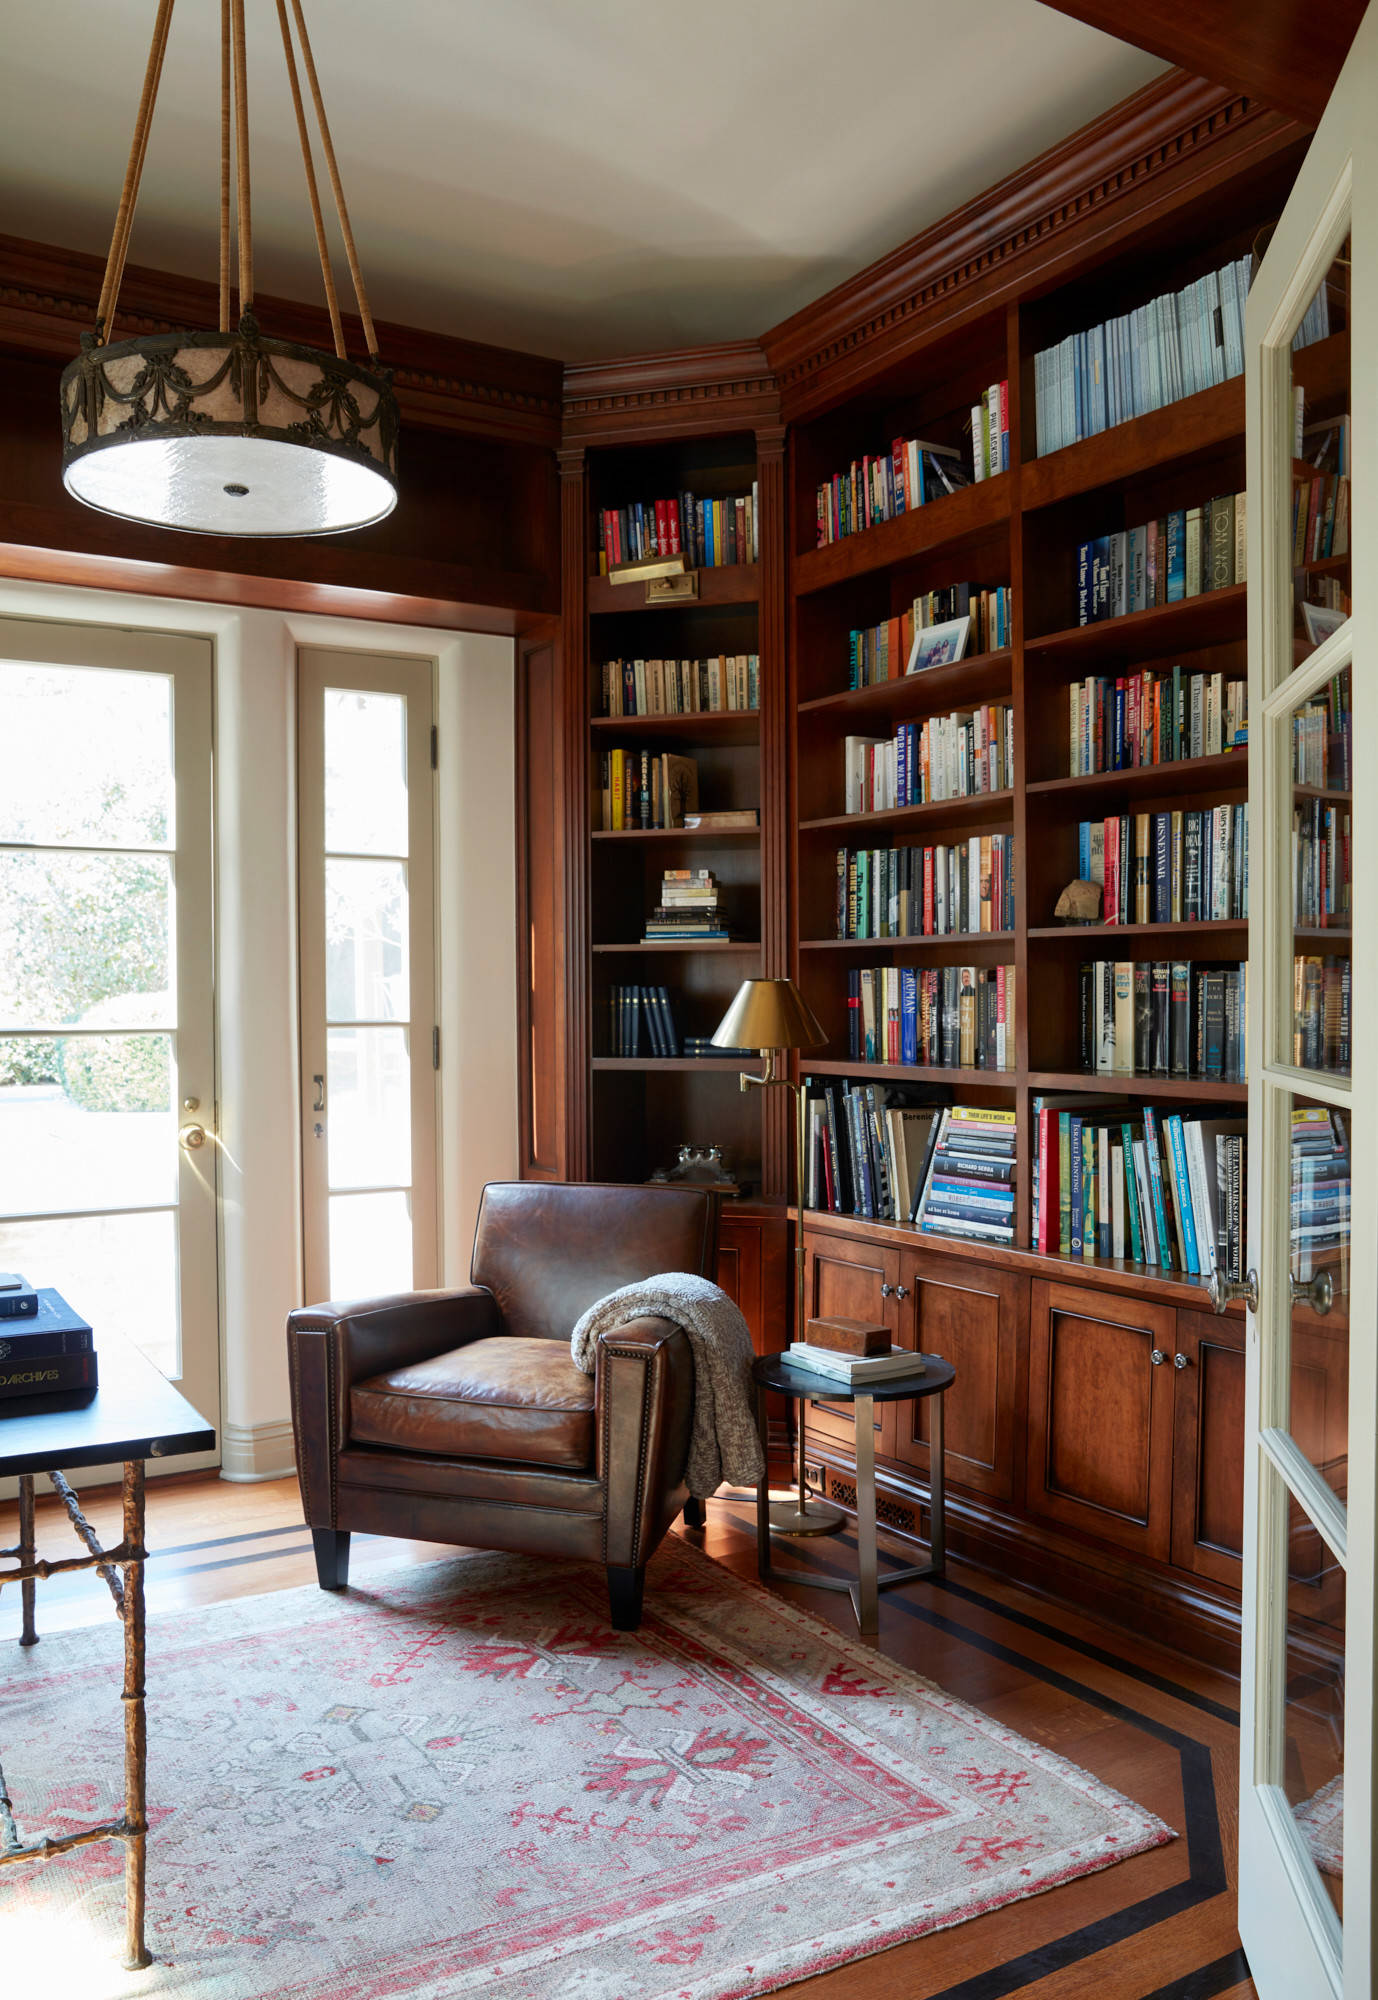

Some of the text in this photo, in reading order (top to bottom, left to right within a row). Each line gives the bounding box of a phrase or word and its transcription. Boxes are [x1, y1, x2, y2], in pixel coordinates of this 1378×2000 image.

[990, 432, 998, 469] JACKSON
[1080, 545, 1088, 562] Tom
[1214, 507, 1229, 589] TOM WOL
[1078, 563, 1088, 587] Clancy
[1098, 565, 1109, 602] Tom Clancy
[1192, 686, 1201, 758] Three Blind Mice
[897, 726, 905, 761] WORLD
[897, 764, 905, 785] WAR
[1157, 817, 1166, 880] DISNEYWAR
[905, 973, 916, 1014] TRUMAN
[902, 1112, 932, 1121] Berenic
[957, 1162, 977, 1170] RICHARD
[1072, 1124, 1080, 1193] ISRAELI PAINTING
[1124, 1132, 1132, 1168] SARGENT
[1179, 1178, 1187, 1208] AMERICA
[1232, 1212, 1239, 1224] OF
[8, 1369, 60, 1385] ARCHIVES
